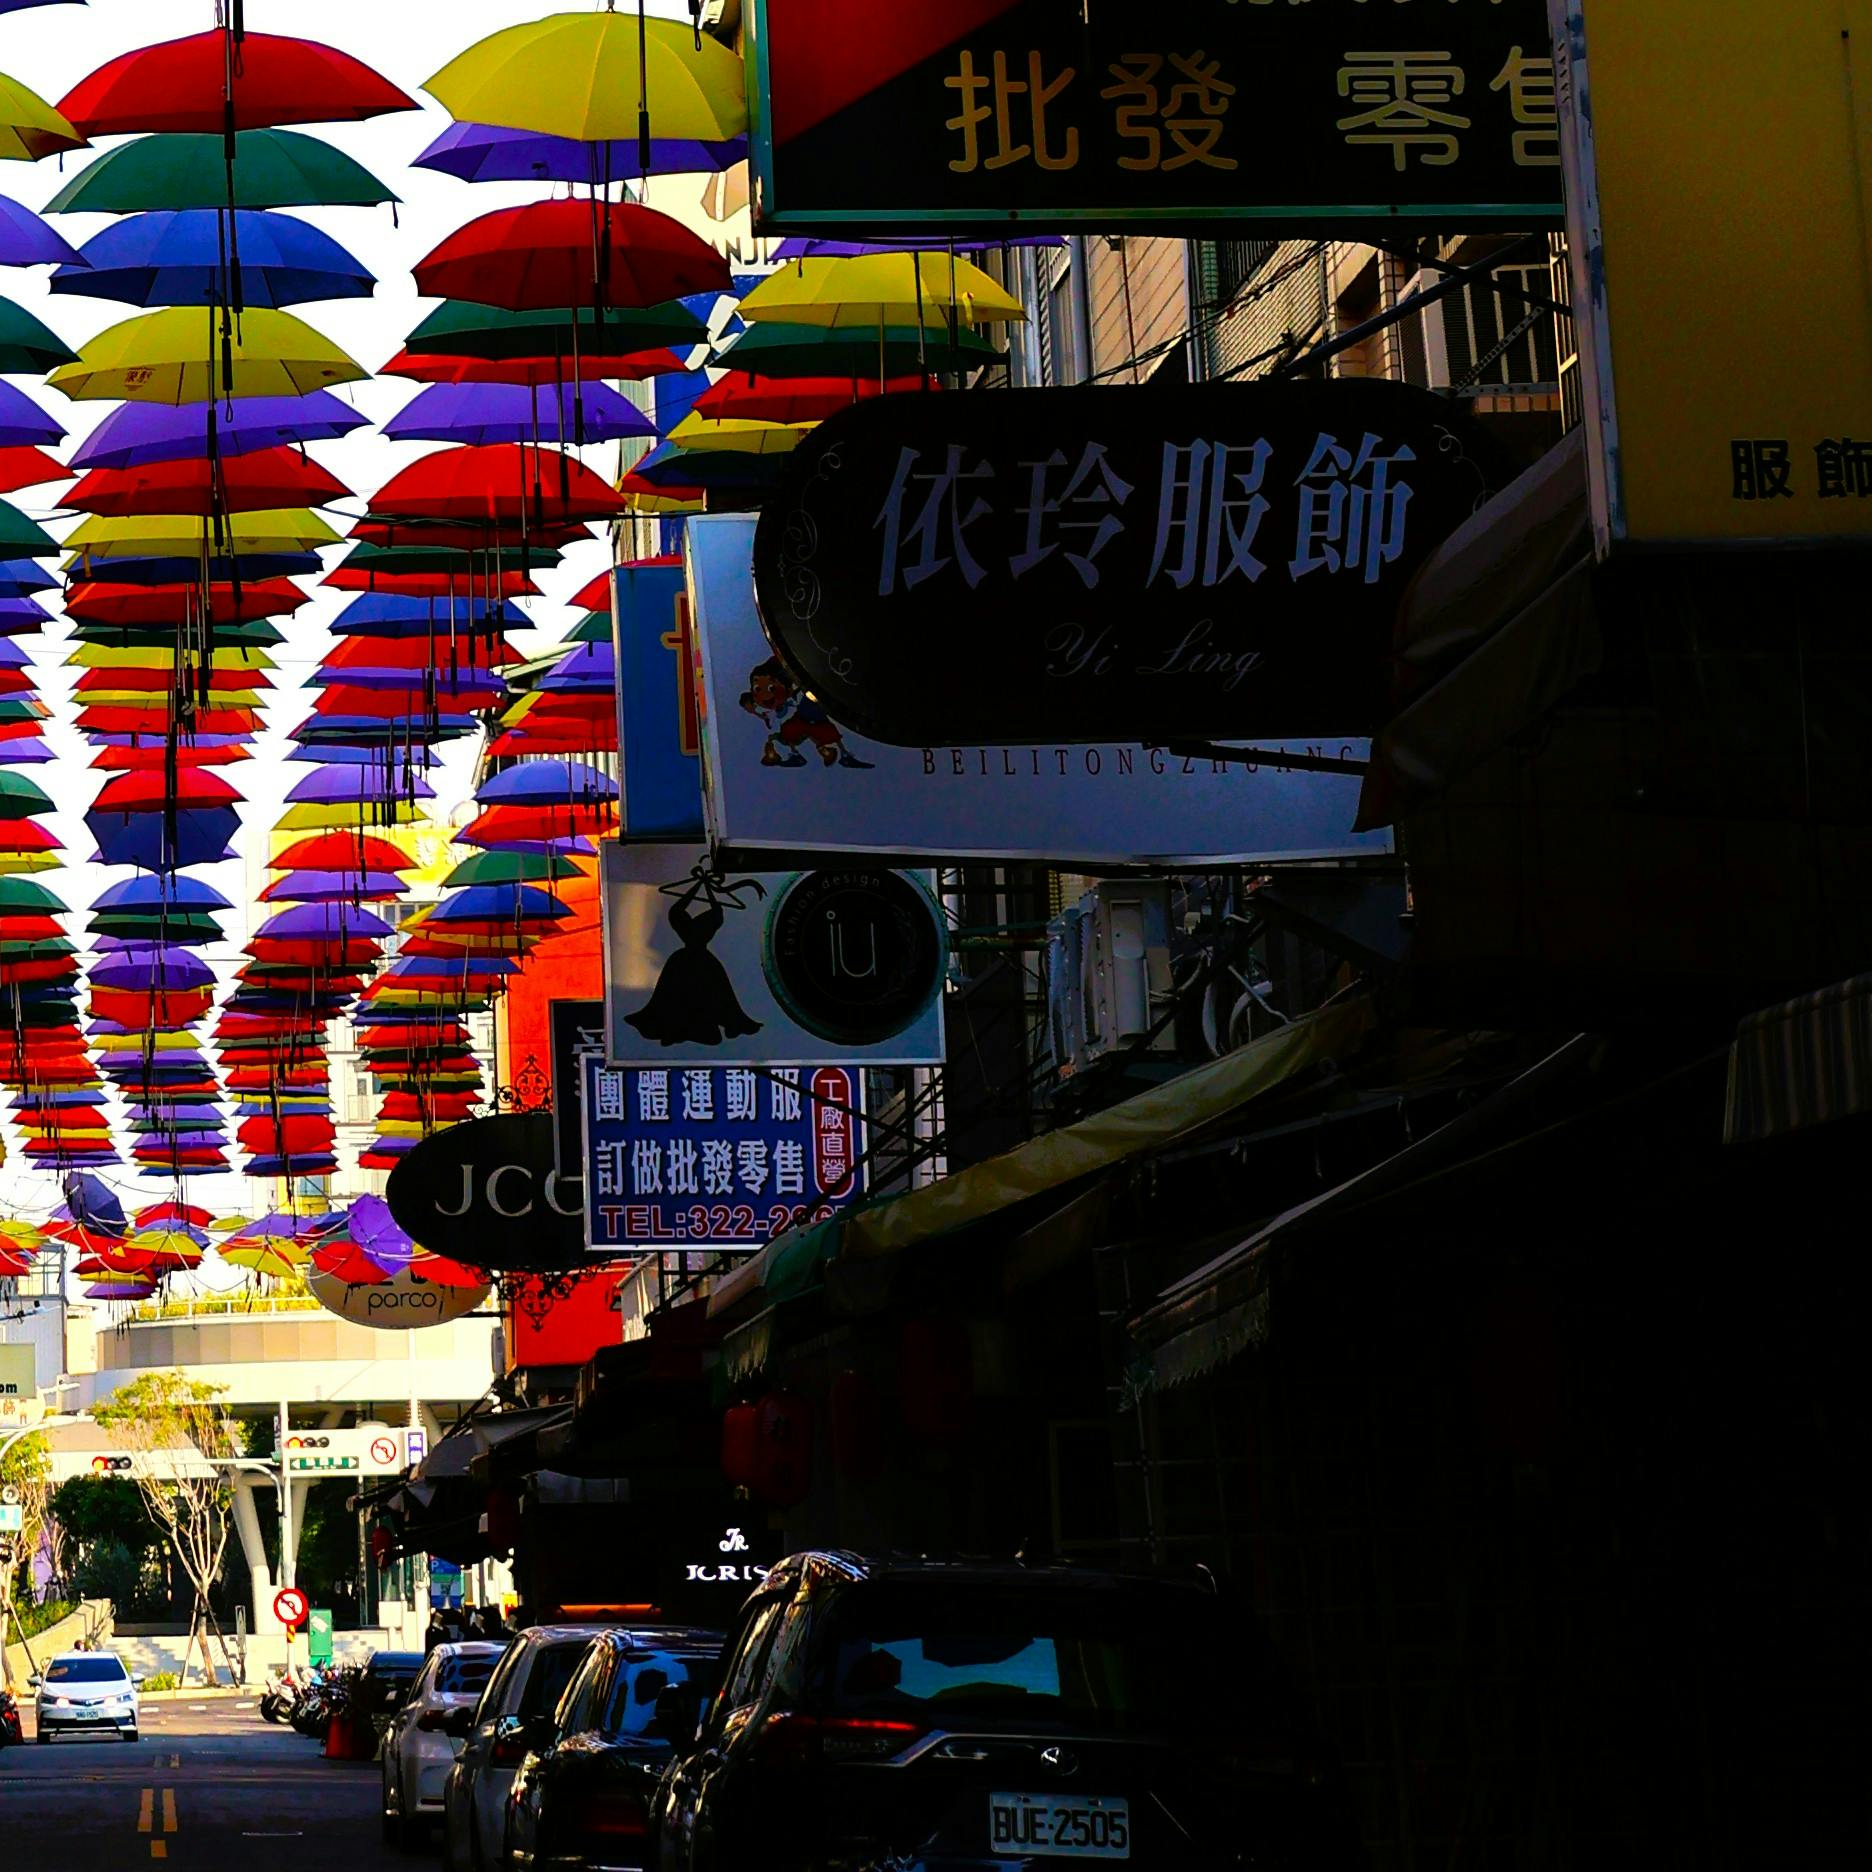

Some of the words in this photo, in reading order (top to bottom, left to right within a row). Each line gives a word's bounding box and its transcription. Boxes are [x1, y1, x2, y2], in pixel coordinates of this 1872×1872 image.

[943, 48, 1239, 174] 批發
[1731, 436, 1872, 500] 服飾
[873, 431, 1418, 598] 依玲服飾
[1136, 616, 1265, 695] Ling
[594, 1065, 802, 1122] 團體運動服
[595, 1138, 805, 1196] 訂做批發零售
[368, 1291, 437, 1316] parco
